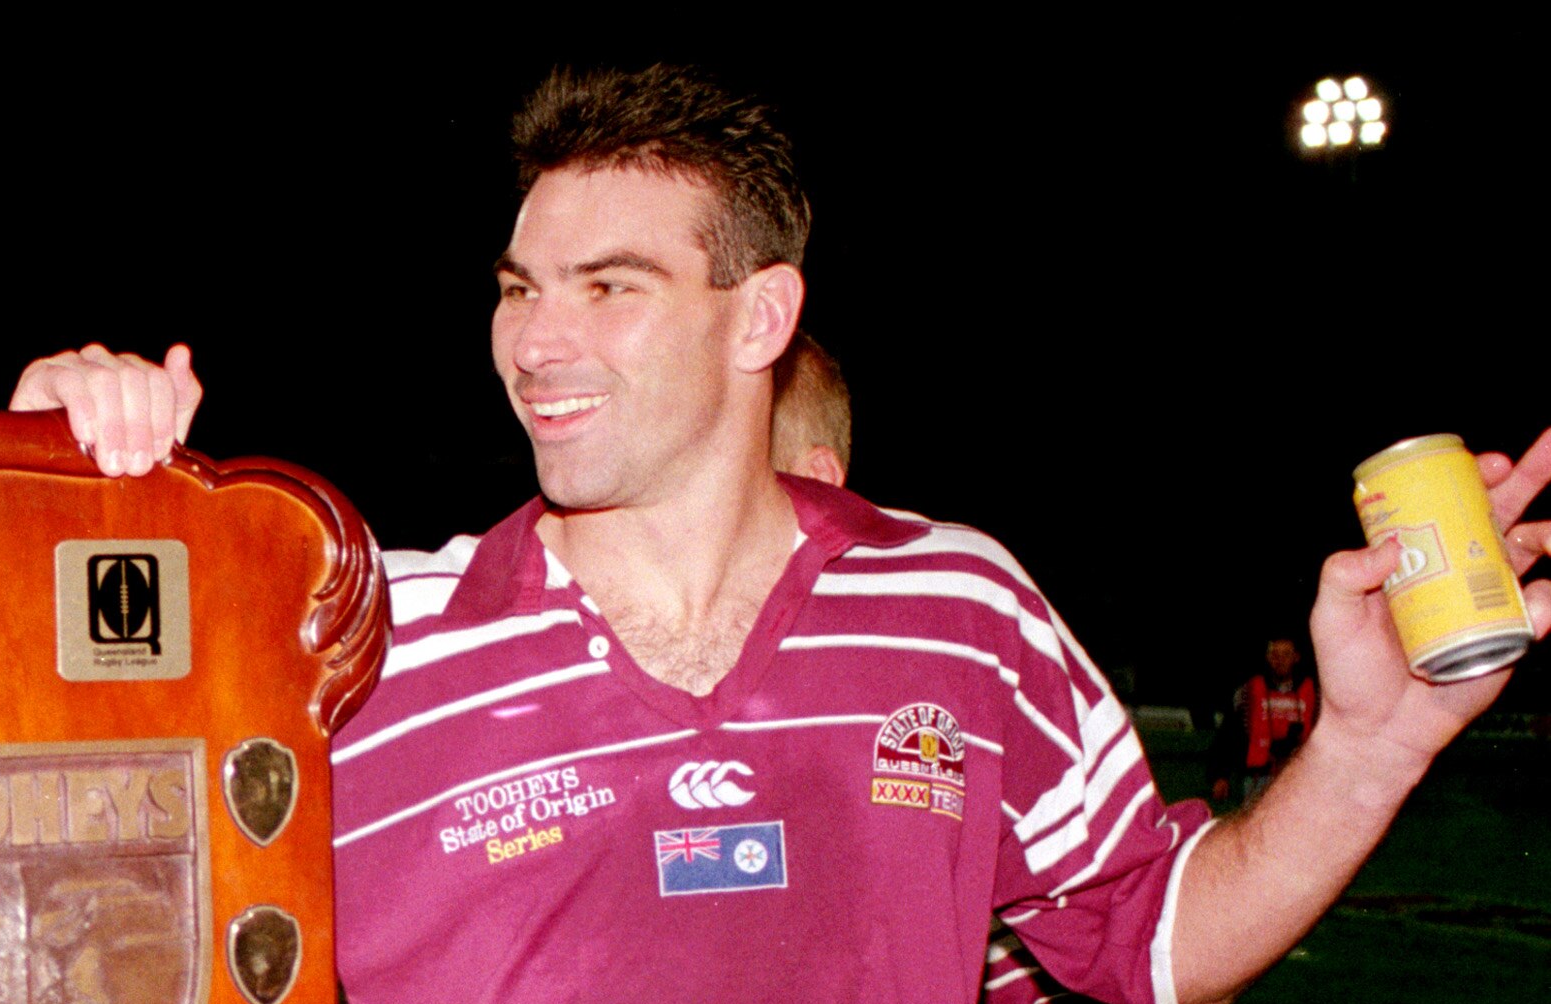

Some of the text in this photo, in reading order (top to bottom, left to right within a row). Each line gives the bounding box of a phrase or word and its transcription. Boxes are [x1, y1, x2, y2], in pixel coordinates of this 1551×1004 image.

[879, 707, 920, 751] STATE
[917, 706, 937, 727] OF
[455, 766, 580, 821] TOOHEYS
[876, 782, 928, 804] XXXX
[439, 785, 617, 854] State of Origin
[485, 826, 564, 865] Series
